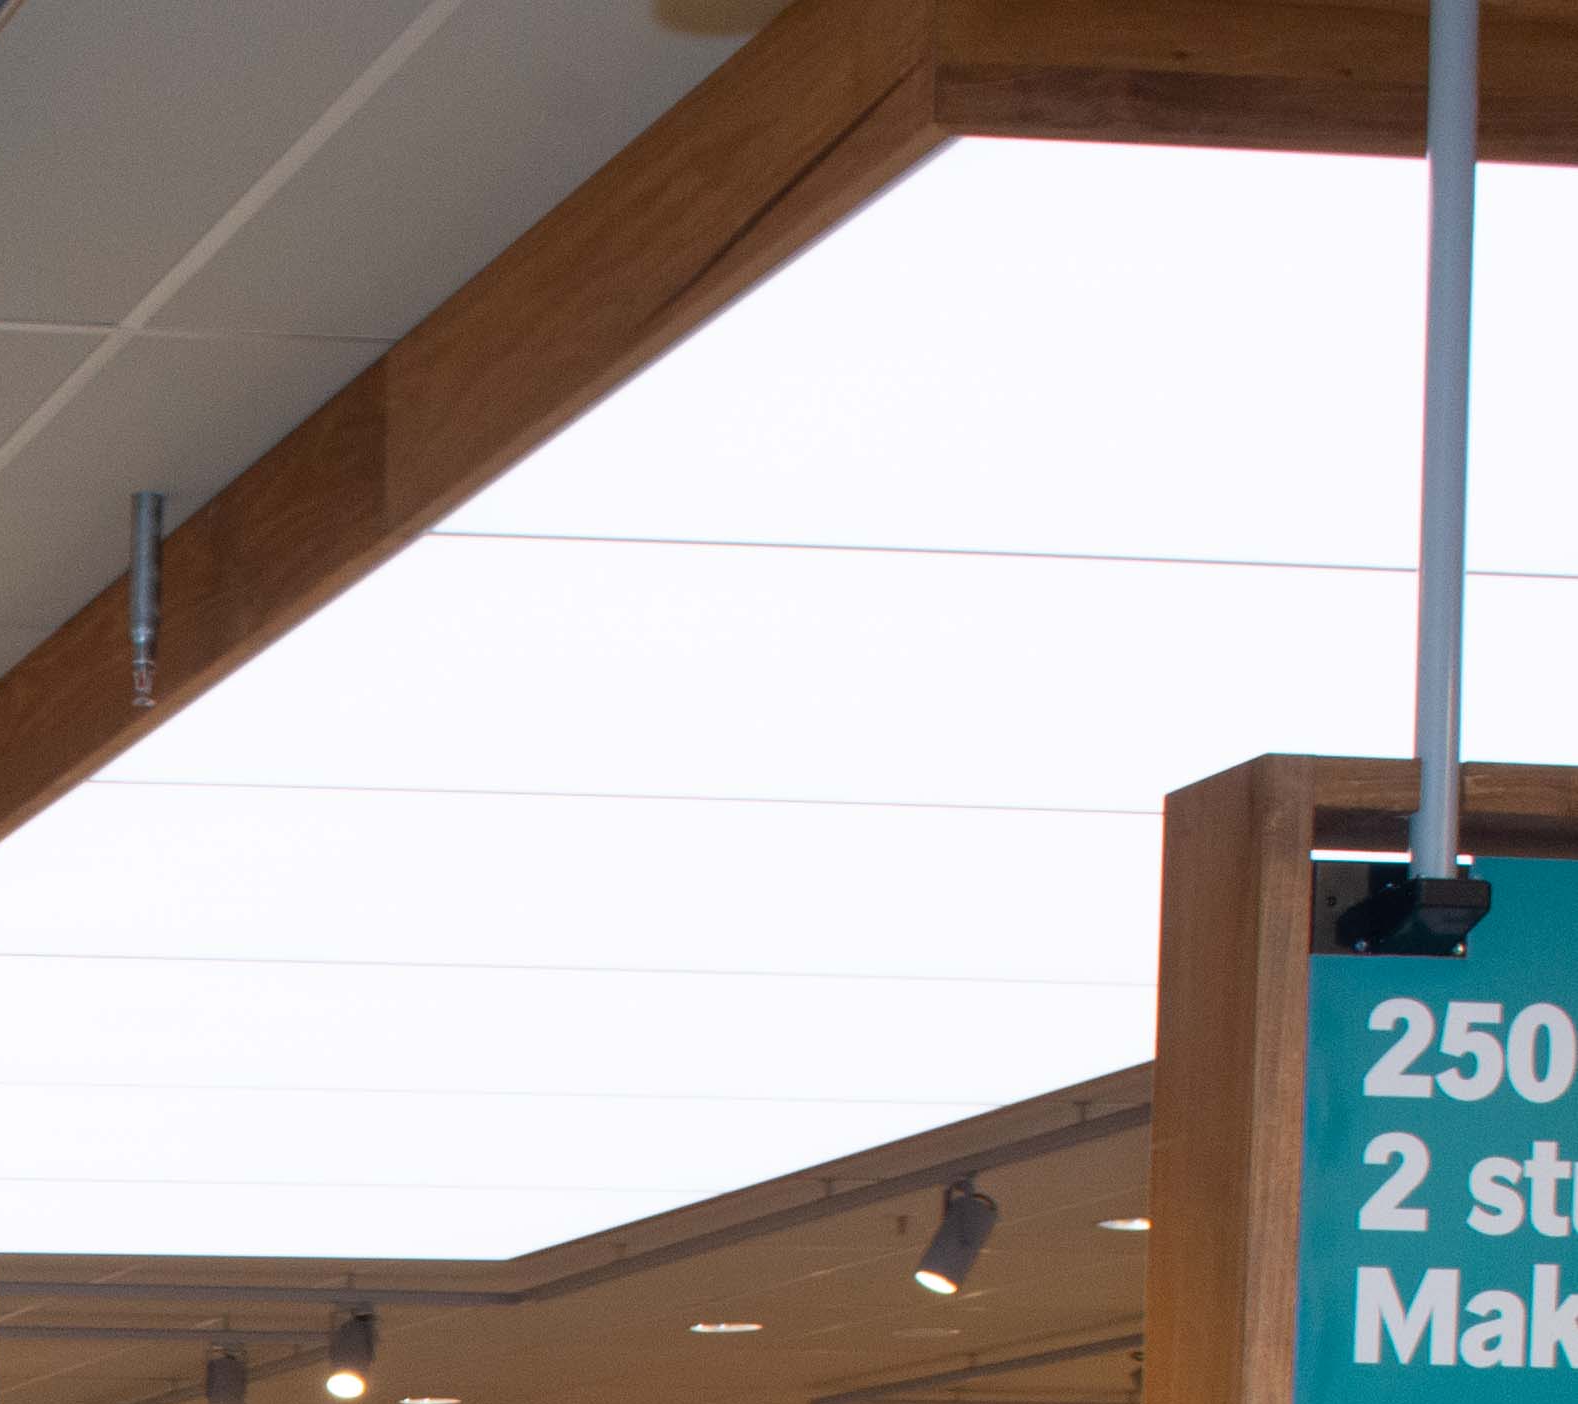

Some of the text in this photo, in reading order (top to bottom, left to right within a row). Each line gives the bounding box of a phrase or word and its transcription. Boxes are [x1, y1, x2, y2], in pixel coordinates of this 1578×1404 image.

[1362, 997, 1577, 1104] 250
[1358, 1131, 1578, 1237] 2 st
